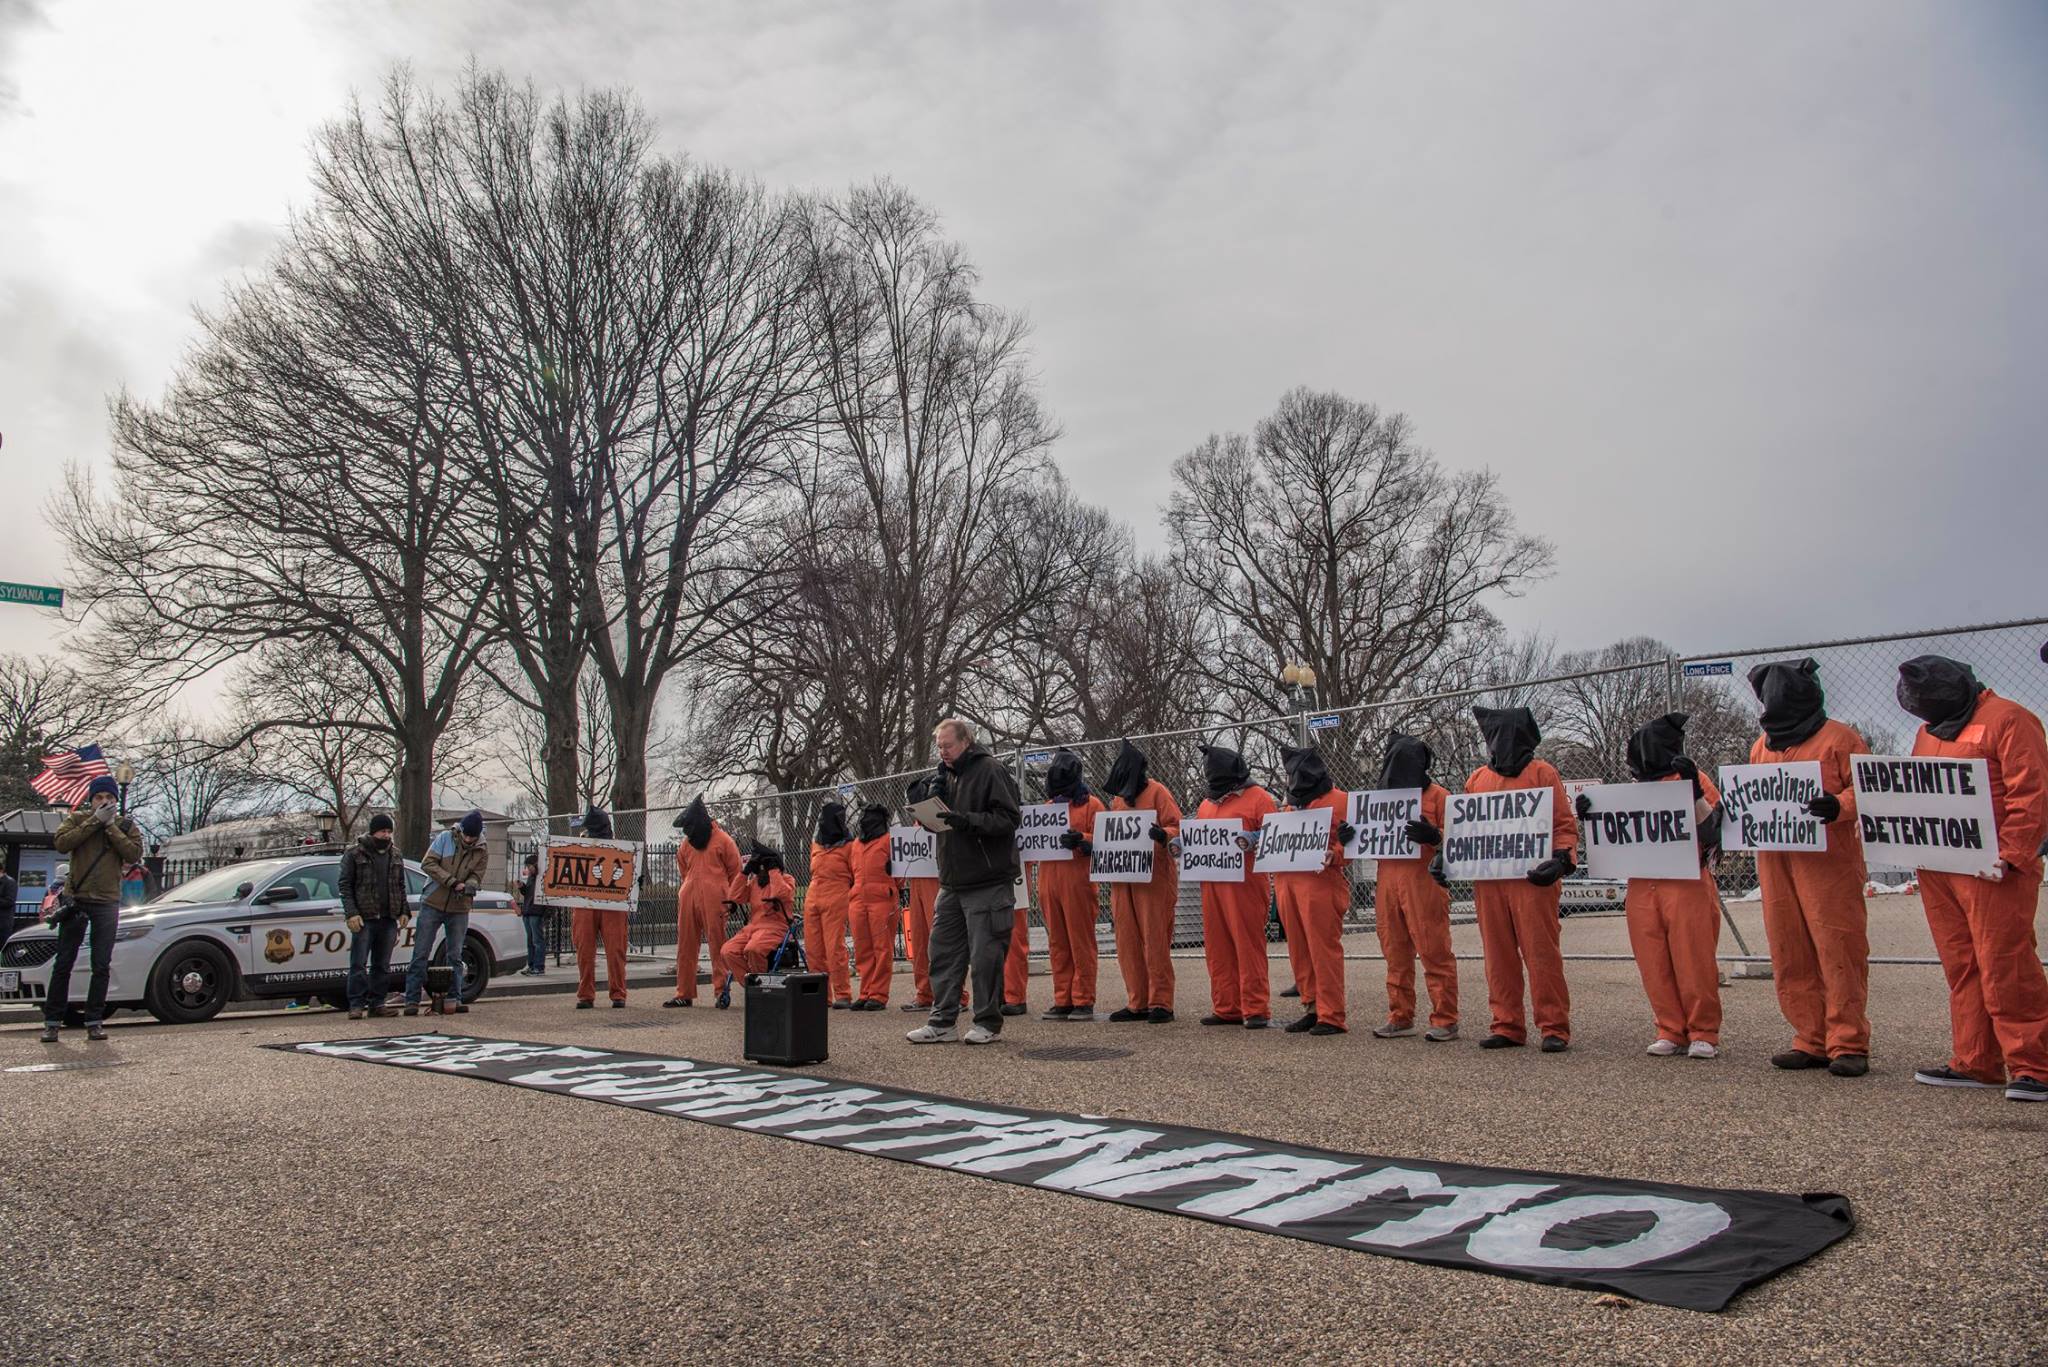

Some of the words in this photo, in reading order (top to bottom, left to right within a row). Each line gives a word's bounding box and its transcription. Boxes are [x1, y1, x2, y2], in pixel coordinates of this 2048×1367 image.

[1684, 666, 1705, 676] LONG
[1706, 664, 1730, 674] FENCE
[1857, 761, 1976, 795] INDEFINITE
[1355, 794, 1418, 833] Hunger
[1453, 791, 1544, 824] SOLITARY
[1104, 816, 1141, 842] MASS
[1255, 820, 1330, 862] Islamophobia
[1583, 810, 1691, 845] TORTURE
[1742, 808, 1817, 847] Rendition
[1860, 814, 1983, 849] DETENTION
[891, 835, 933, 862] Home!
[1090, 850, 1153, 874] INCARCERATION
[1446, 833, 1549, 864] CONFINEMENT
[548, 855, 593, 888] JAN
[1560, 888, 1604, 899] OLICE
[264, 973, 304, 984] UNITED
[305, 969, 341, 982] STATES
